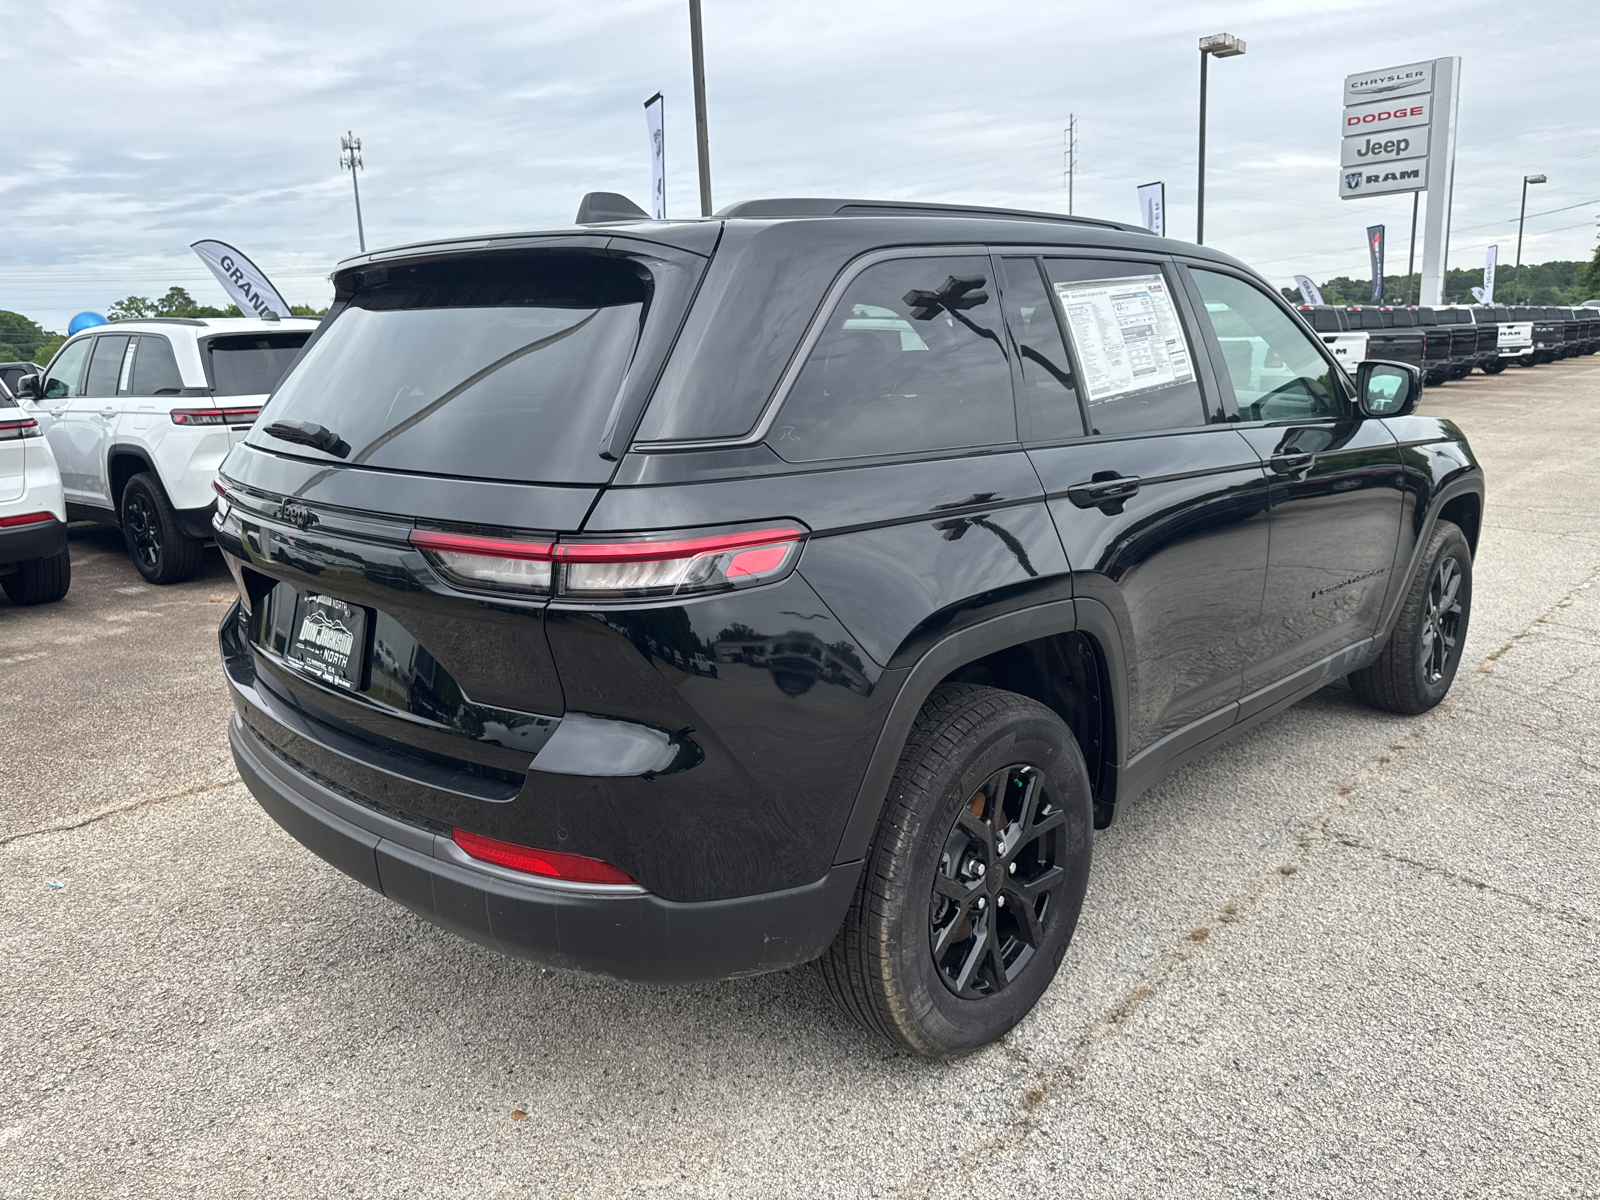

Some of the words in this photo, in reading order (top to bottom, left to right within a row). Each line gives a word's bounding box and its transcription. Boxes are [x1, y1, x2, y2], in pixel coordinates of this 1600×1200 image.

[1351, 71, 1423, 88] CHRYSLER
[1347, 106, 1423, 126] DODGE
[1357, 138, 1410, 157] Jeep
[1366, 169, 1419, 184] RAM
[299, 619, 319, 642] DON
[316, 626, 354, 656] JACKSON
[322, 649, 348, 668] NORTH
